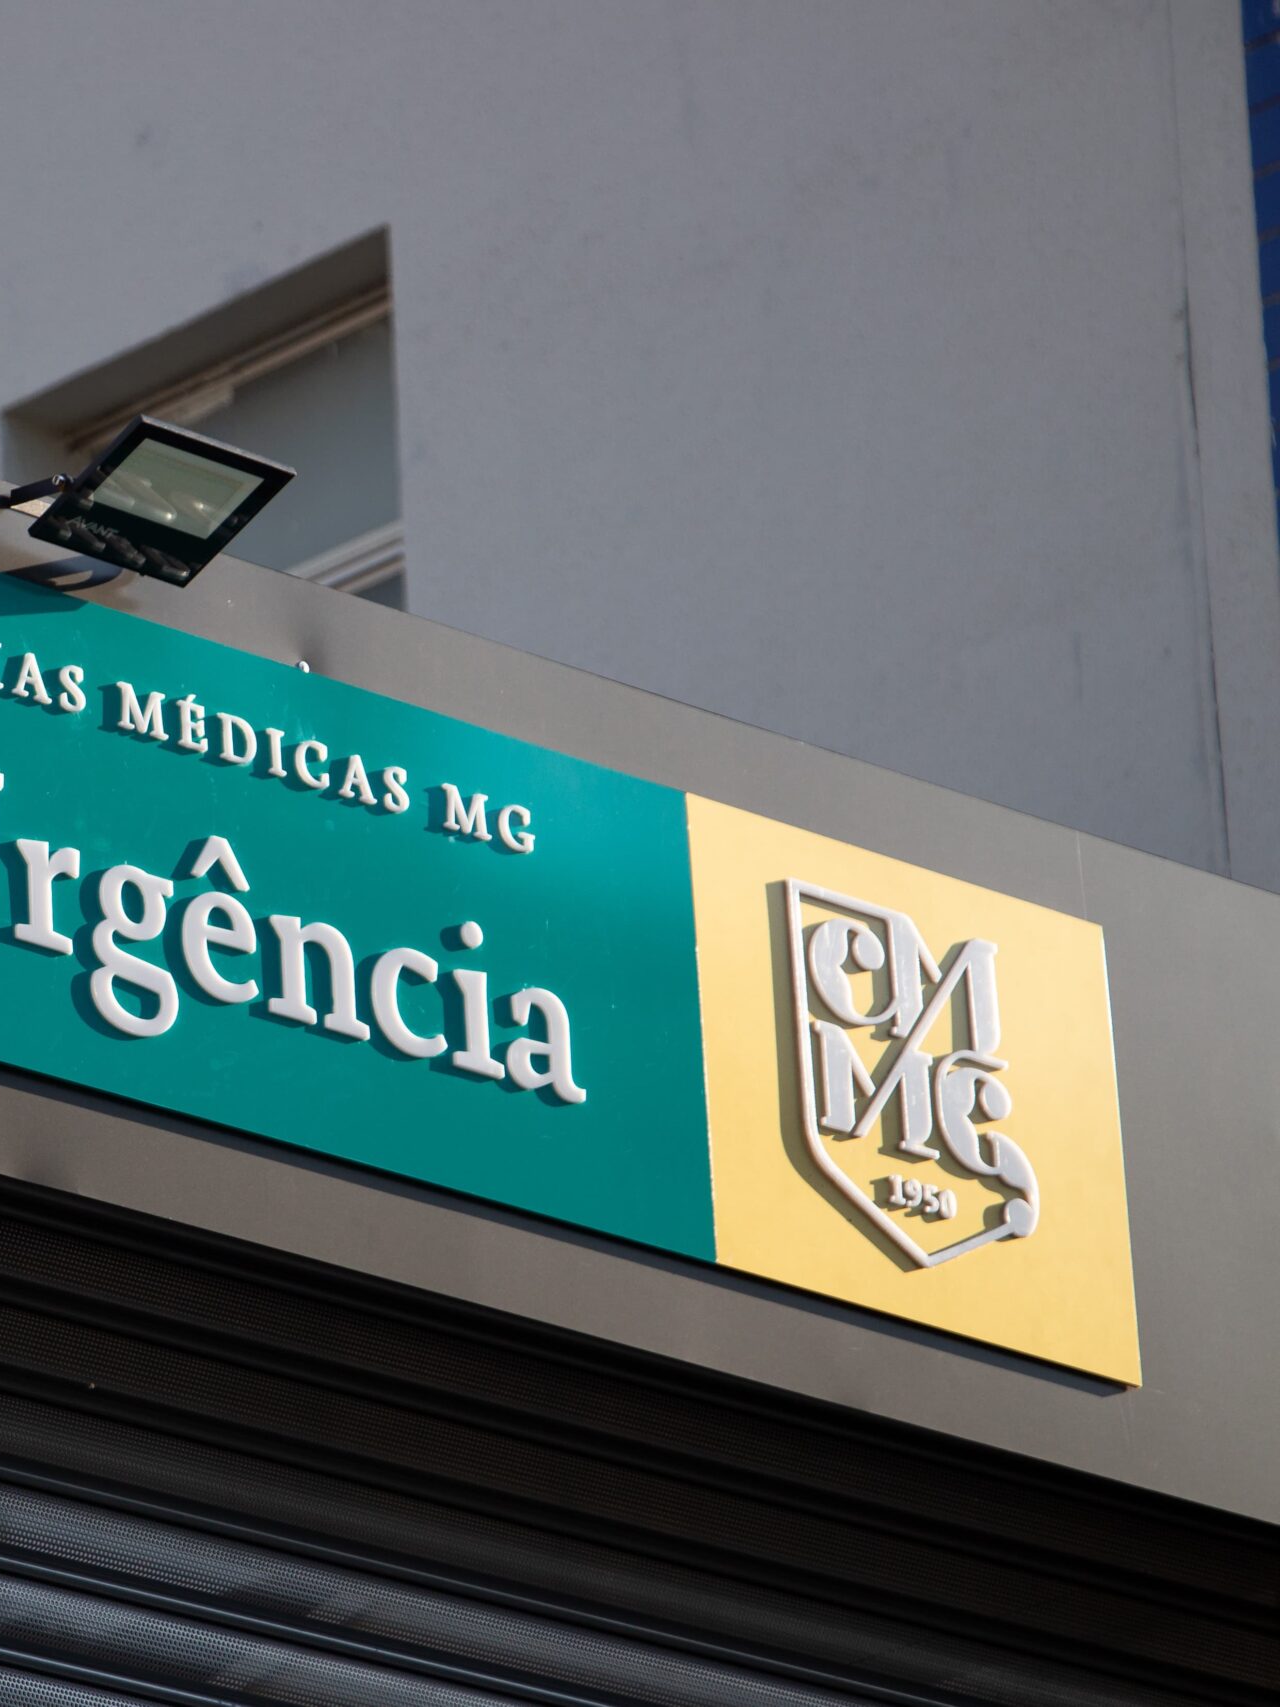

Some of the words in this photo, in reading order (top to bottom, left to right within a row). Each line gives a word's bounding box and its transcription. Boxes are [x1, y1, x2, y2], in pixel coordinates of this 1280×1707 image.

[66, 515, 119, 538] AVANT
[116, 681, 410, 814] MÉDICAS
[441, 783, 536, 854] MG
[888, 1174, 958, 1219] 1950
